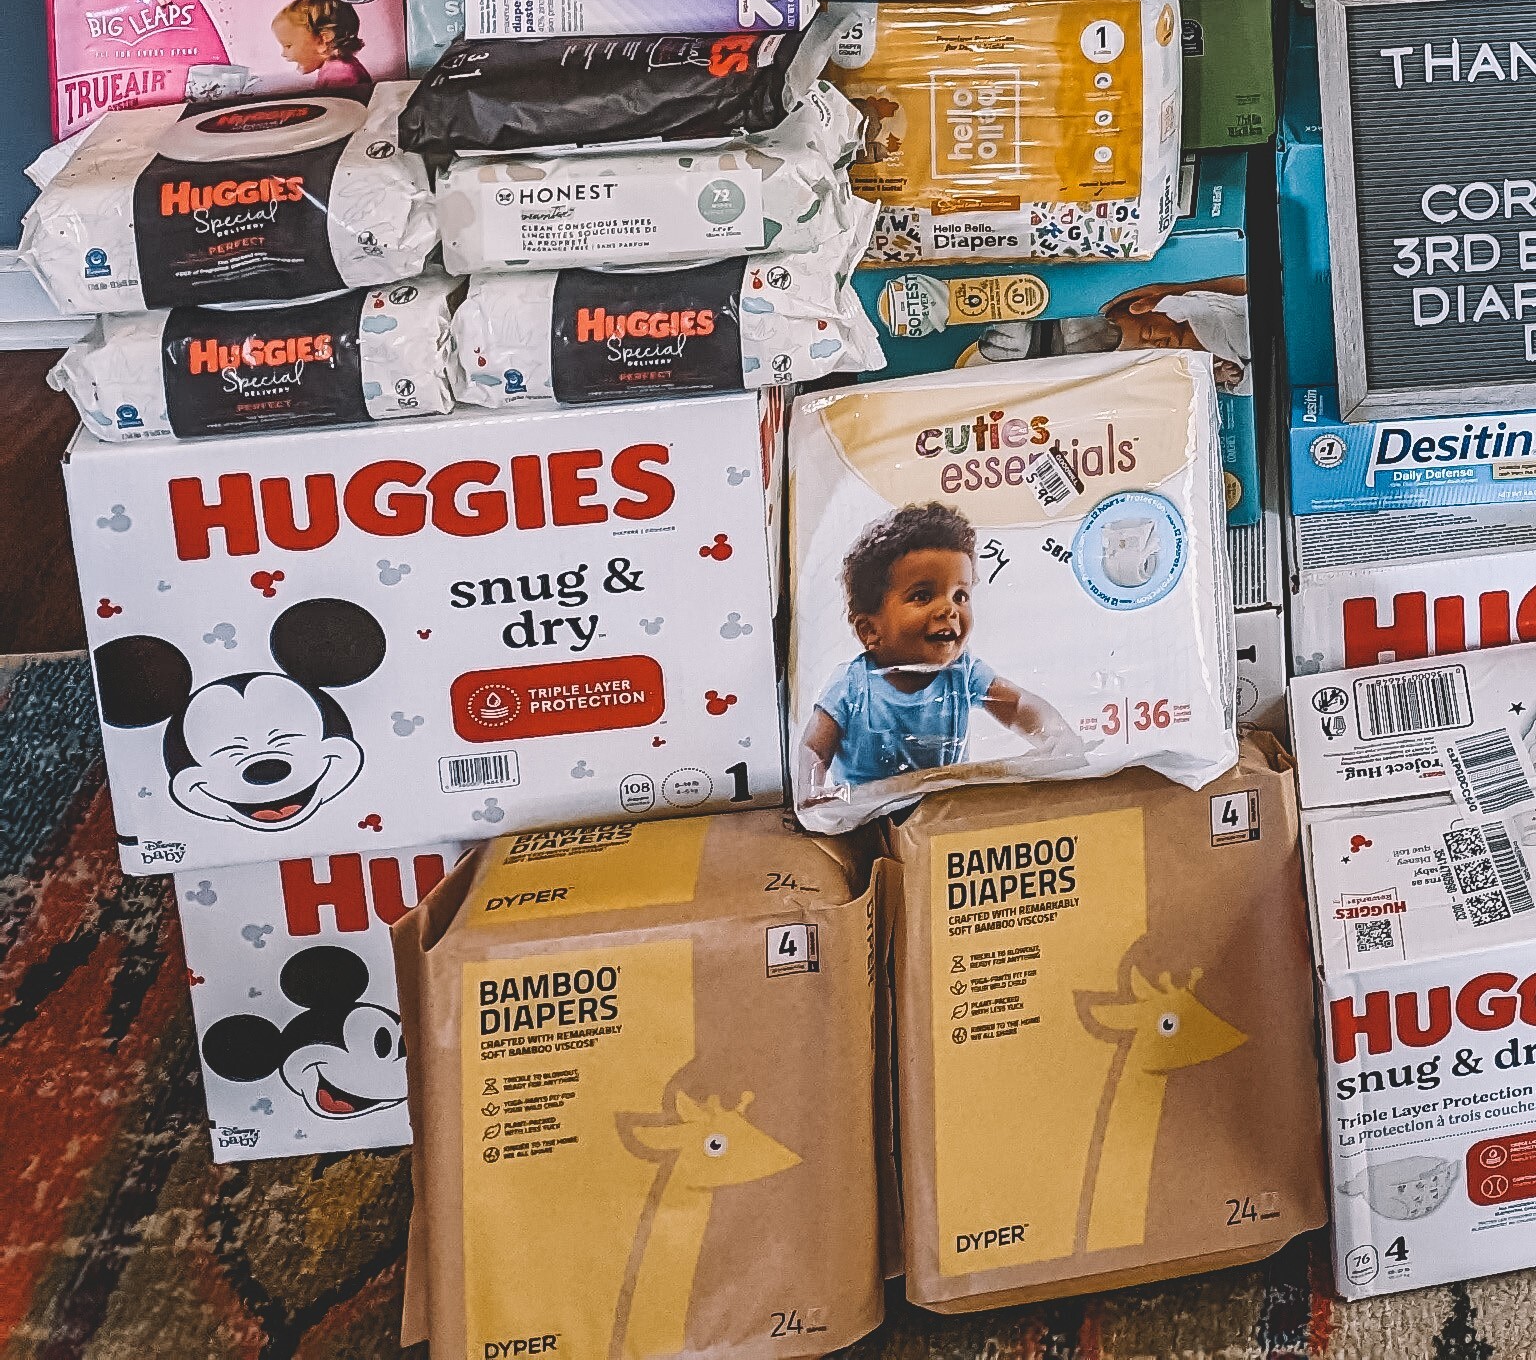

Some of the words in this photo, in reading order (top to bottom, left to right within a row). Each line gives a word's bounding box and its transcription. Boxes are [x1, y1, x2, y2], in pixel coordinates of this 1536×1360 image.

[87, 15, 123, 39] BIG
[128, 3, 196, 35] LEAPS
[1096, 25, 1107, 50] 1
[64, 69, 166, 126] TRUEAIR
[519, 183, 617, 205] HONEST
[521, 223, 556, 233] CLEAN
[557, 220, 619, 231] CONSCIOUS
[621, 218, 652, 227] WIPES
[934, 232, 1019, 250] Diapers
[1392, 233, 1501, 278] 3RD
[222, 359, 305, 396] Special
[914, 411, 1052, 460] cuties
[1375, 421, 1533, 465] Desitin
[1393, 468, 1422, 482] Daily
[1424, 467, 1475, 481] Defense
[168, 442, 676, 561] HUGGIES
[449, 563, 588, 609] snug
[603, 556, 646, 594] &
[501, 609, 599, 653] dry
[527, 683, 576, 700] TRIPLE
[577, 678, 633, 696] LAYER
[529, 689, 647, 715] PROTECTION
[1101, 703, 1122, 736] 3
[1133, 697, 1172, 731] 36
[623, 781, 651, 796] 108
[724, 761, 754, 803] 1
[947, 835, 1077, 880] BAMBOO
[947, 865, 1077, 911] DIAPERS
[479, 994, 619, 1037] DIAPERS
[480, 1048, 507, 1061] SOFT
[508, 1043, 554, 1058] BAMBOO
[1336, 1056, 1442, 1102] snug
[1451, 1047, 1484, 1078] &
[1337, 1106, 1389, 1131] Triple
[1391, 1098, 1440, 1122] Layer
[1442, 1083, 1534, 1112] Protection
[1225, 1195, 1258, 1228] 24
[769, 1310, 803, 1338] 24
